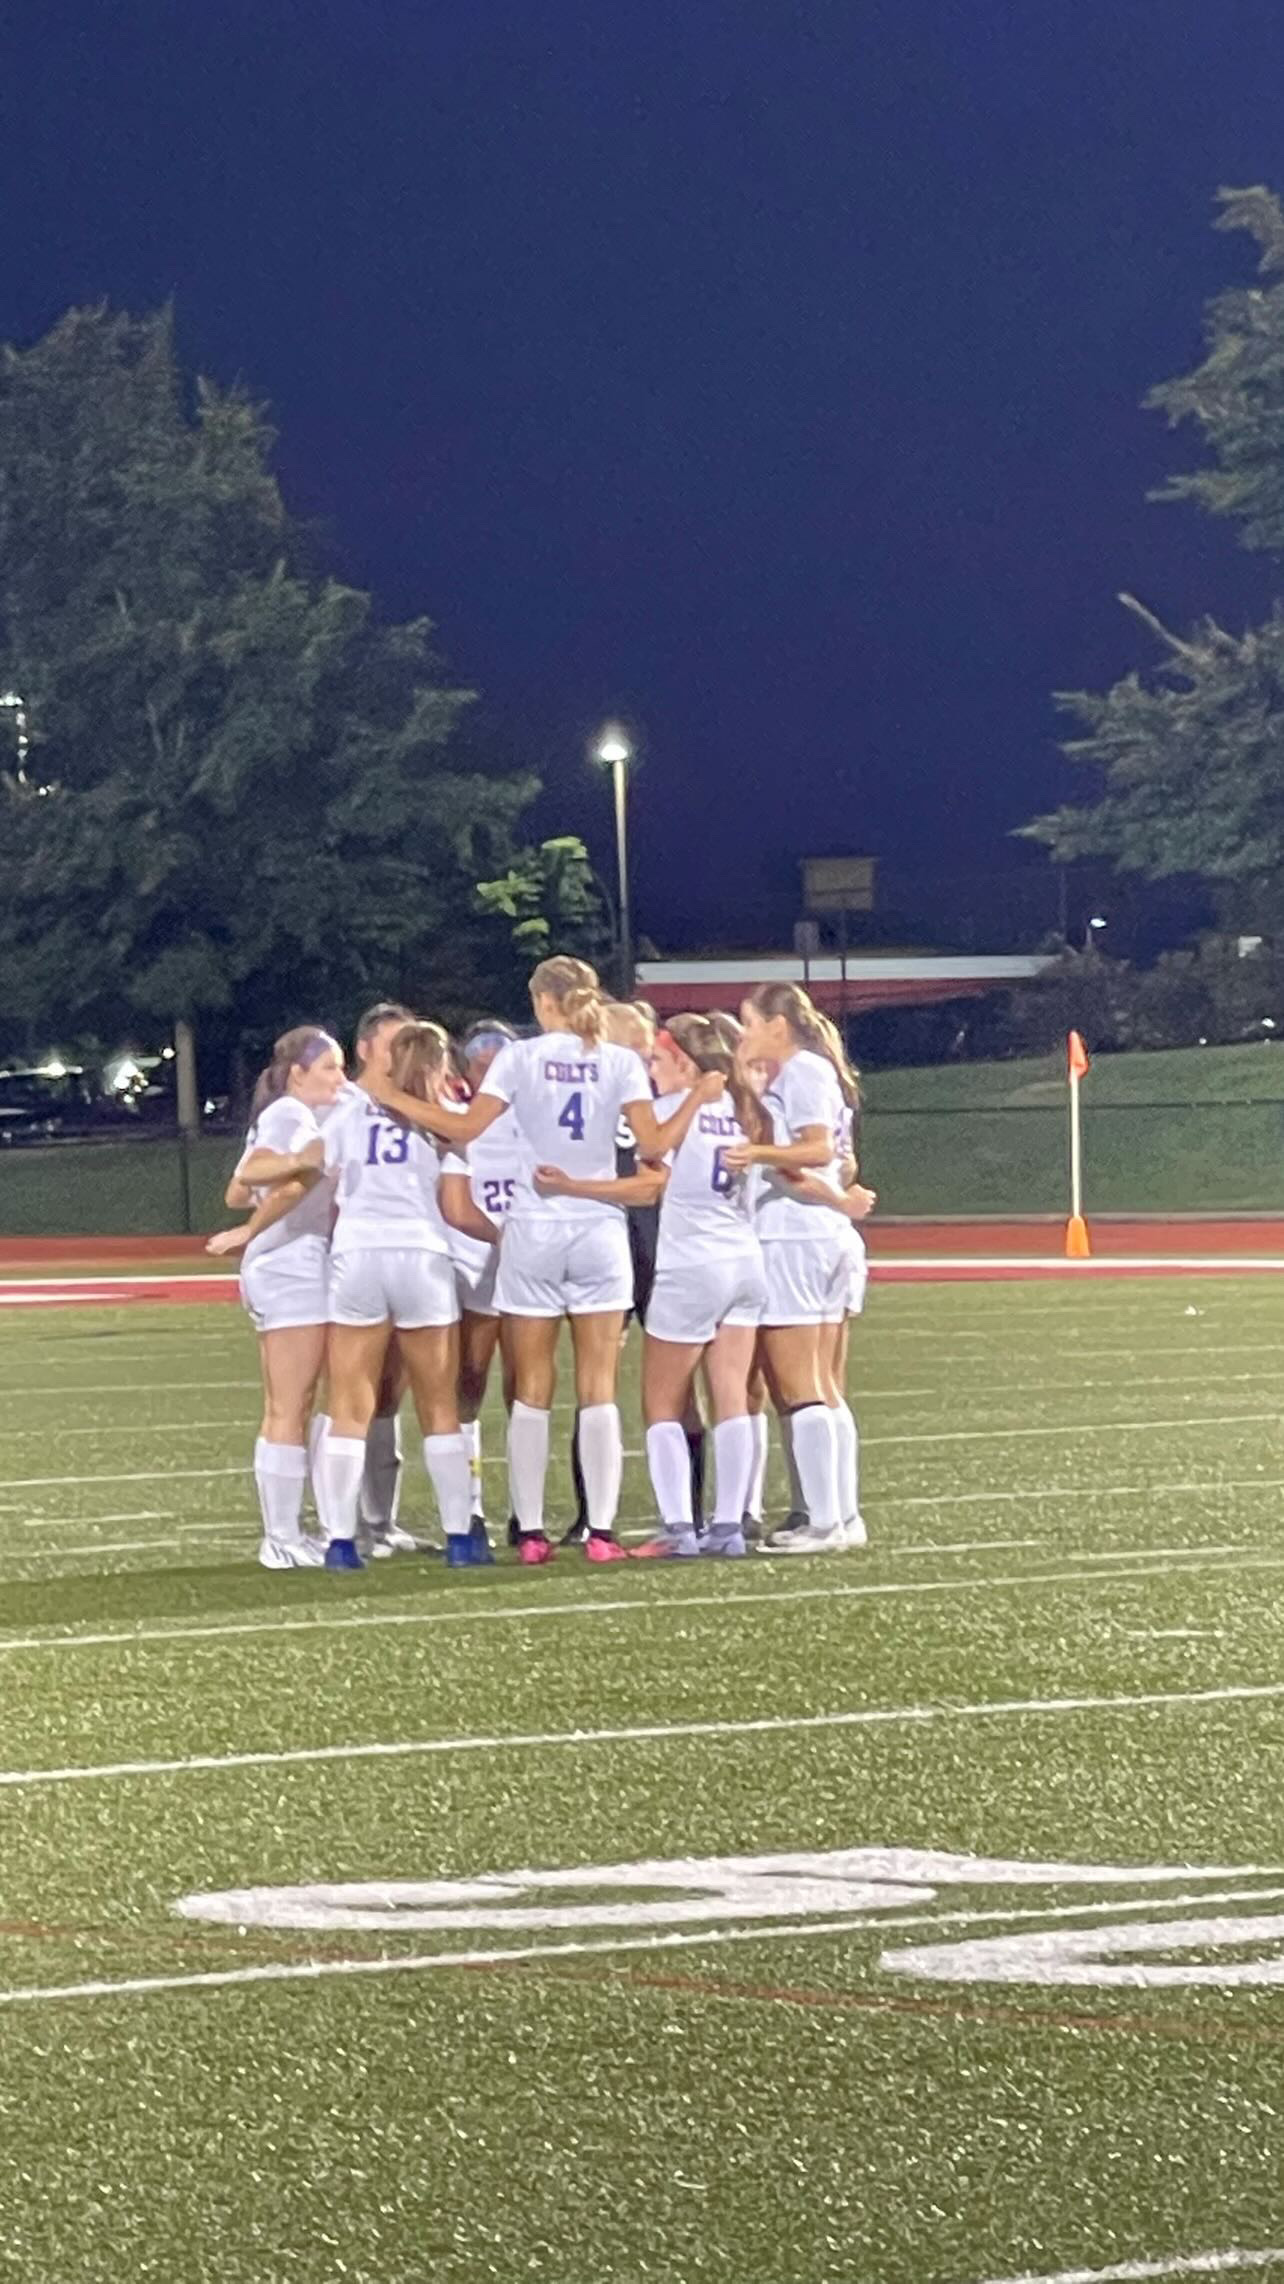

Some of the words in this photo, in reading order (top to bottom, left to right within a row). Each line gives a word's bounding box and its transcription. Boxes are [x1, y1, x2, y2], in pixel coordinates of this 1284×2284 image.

[544, 1061, 599, 1083] COLTS
[558, 1091, 584, 1141] 4
[365, 1123, 410, 1165] 13
